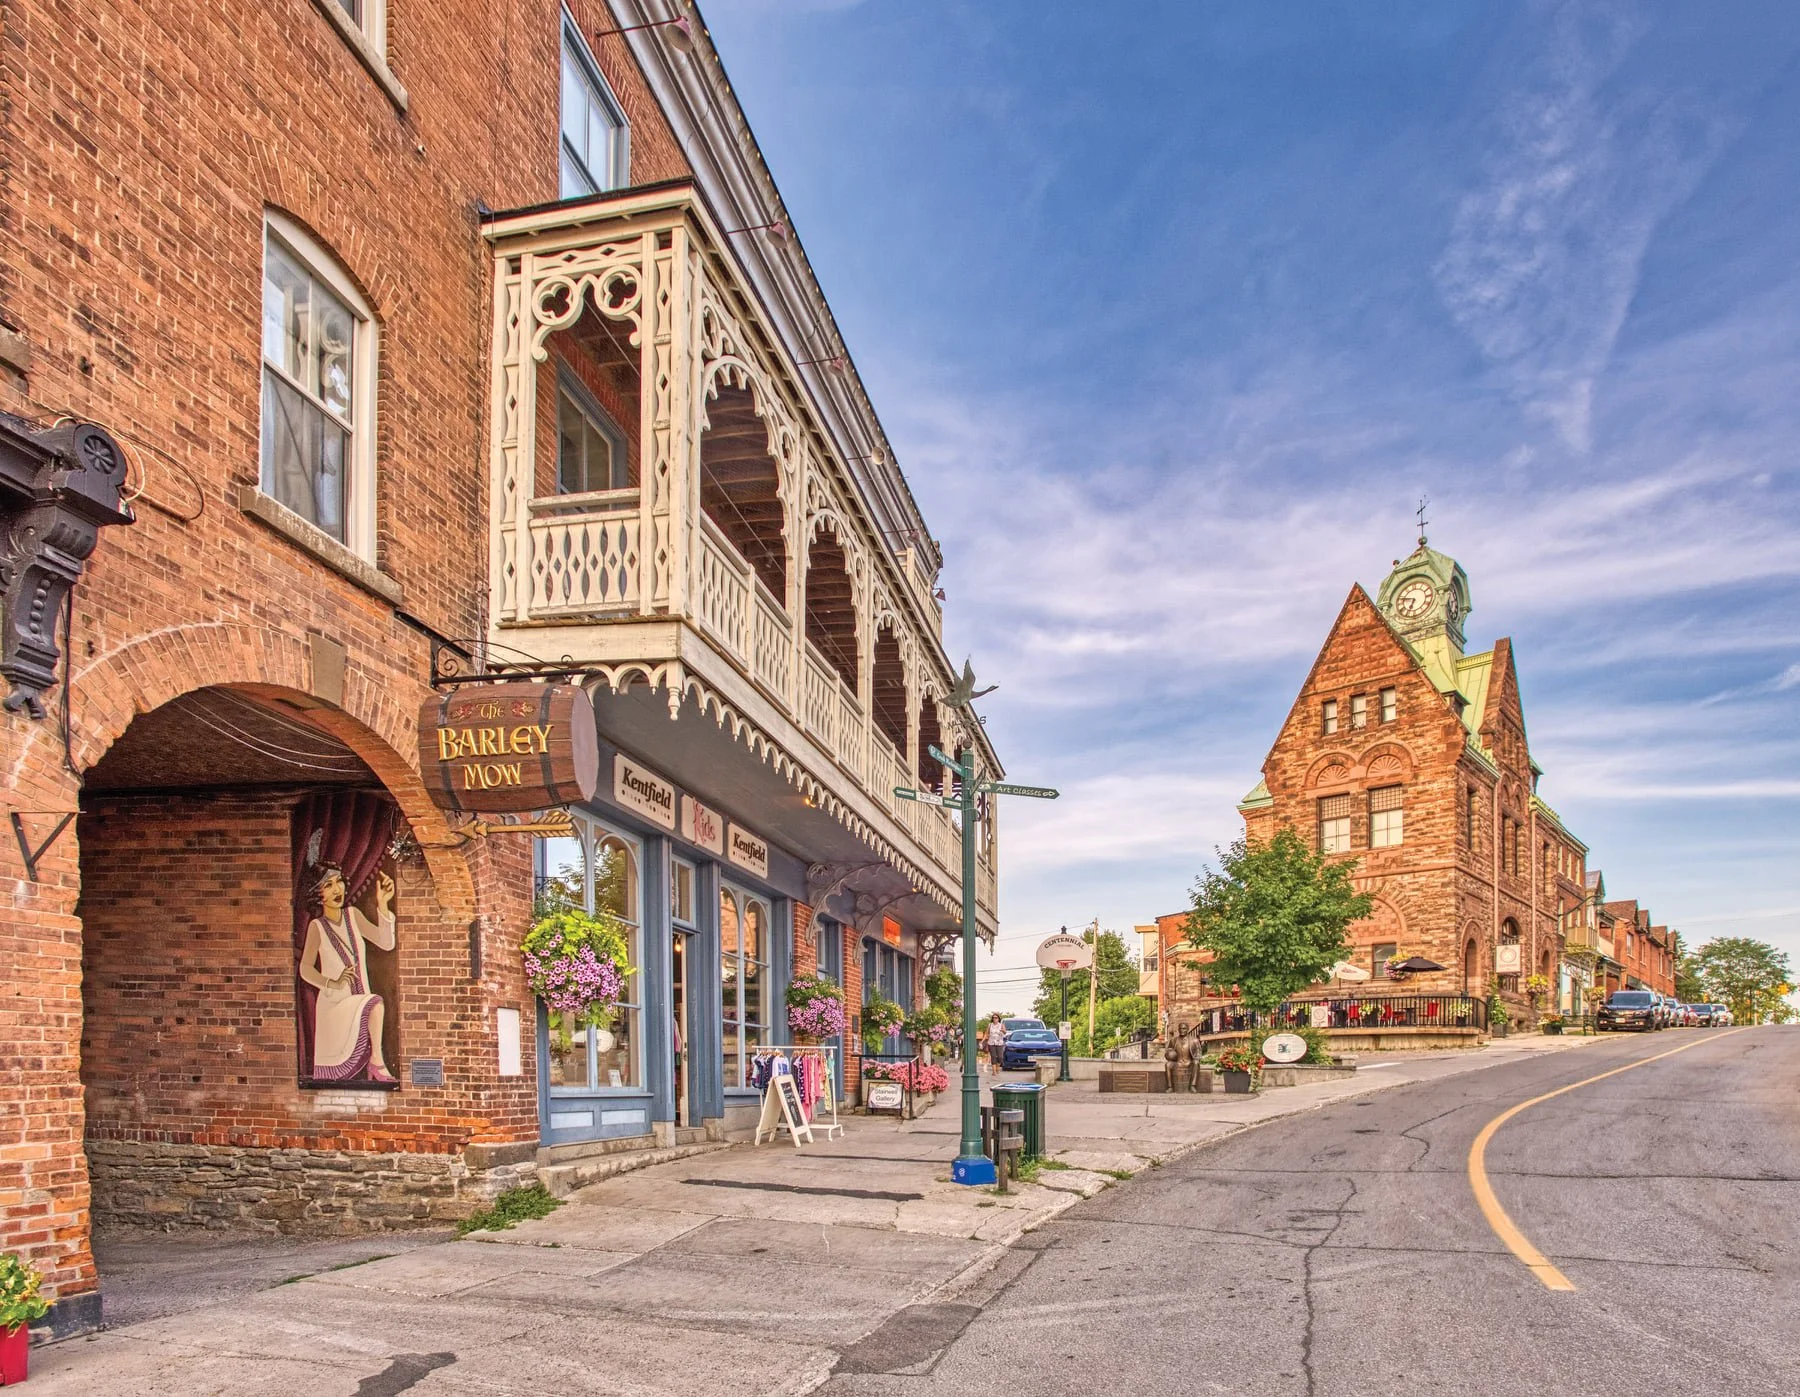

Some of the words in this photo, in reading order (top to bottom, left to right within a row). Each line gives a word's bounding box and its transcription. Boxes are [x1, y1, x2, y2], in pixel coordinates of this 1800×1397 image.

[476, 701, 505, 720] The
[437, 724, 554, 761] BARLEY
[463, 762, 522, 790] MOW
[622, 766, 672, 810] Kentfield
[996, 786, 1011, 794] Art
[1013, 788, 1042, 797] Classes
[693, 797, 716, 846] Kids
[733, 832, 766, 863] Kentfield
[1044, 937, 1085, 949] CENTENNIAL
